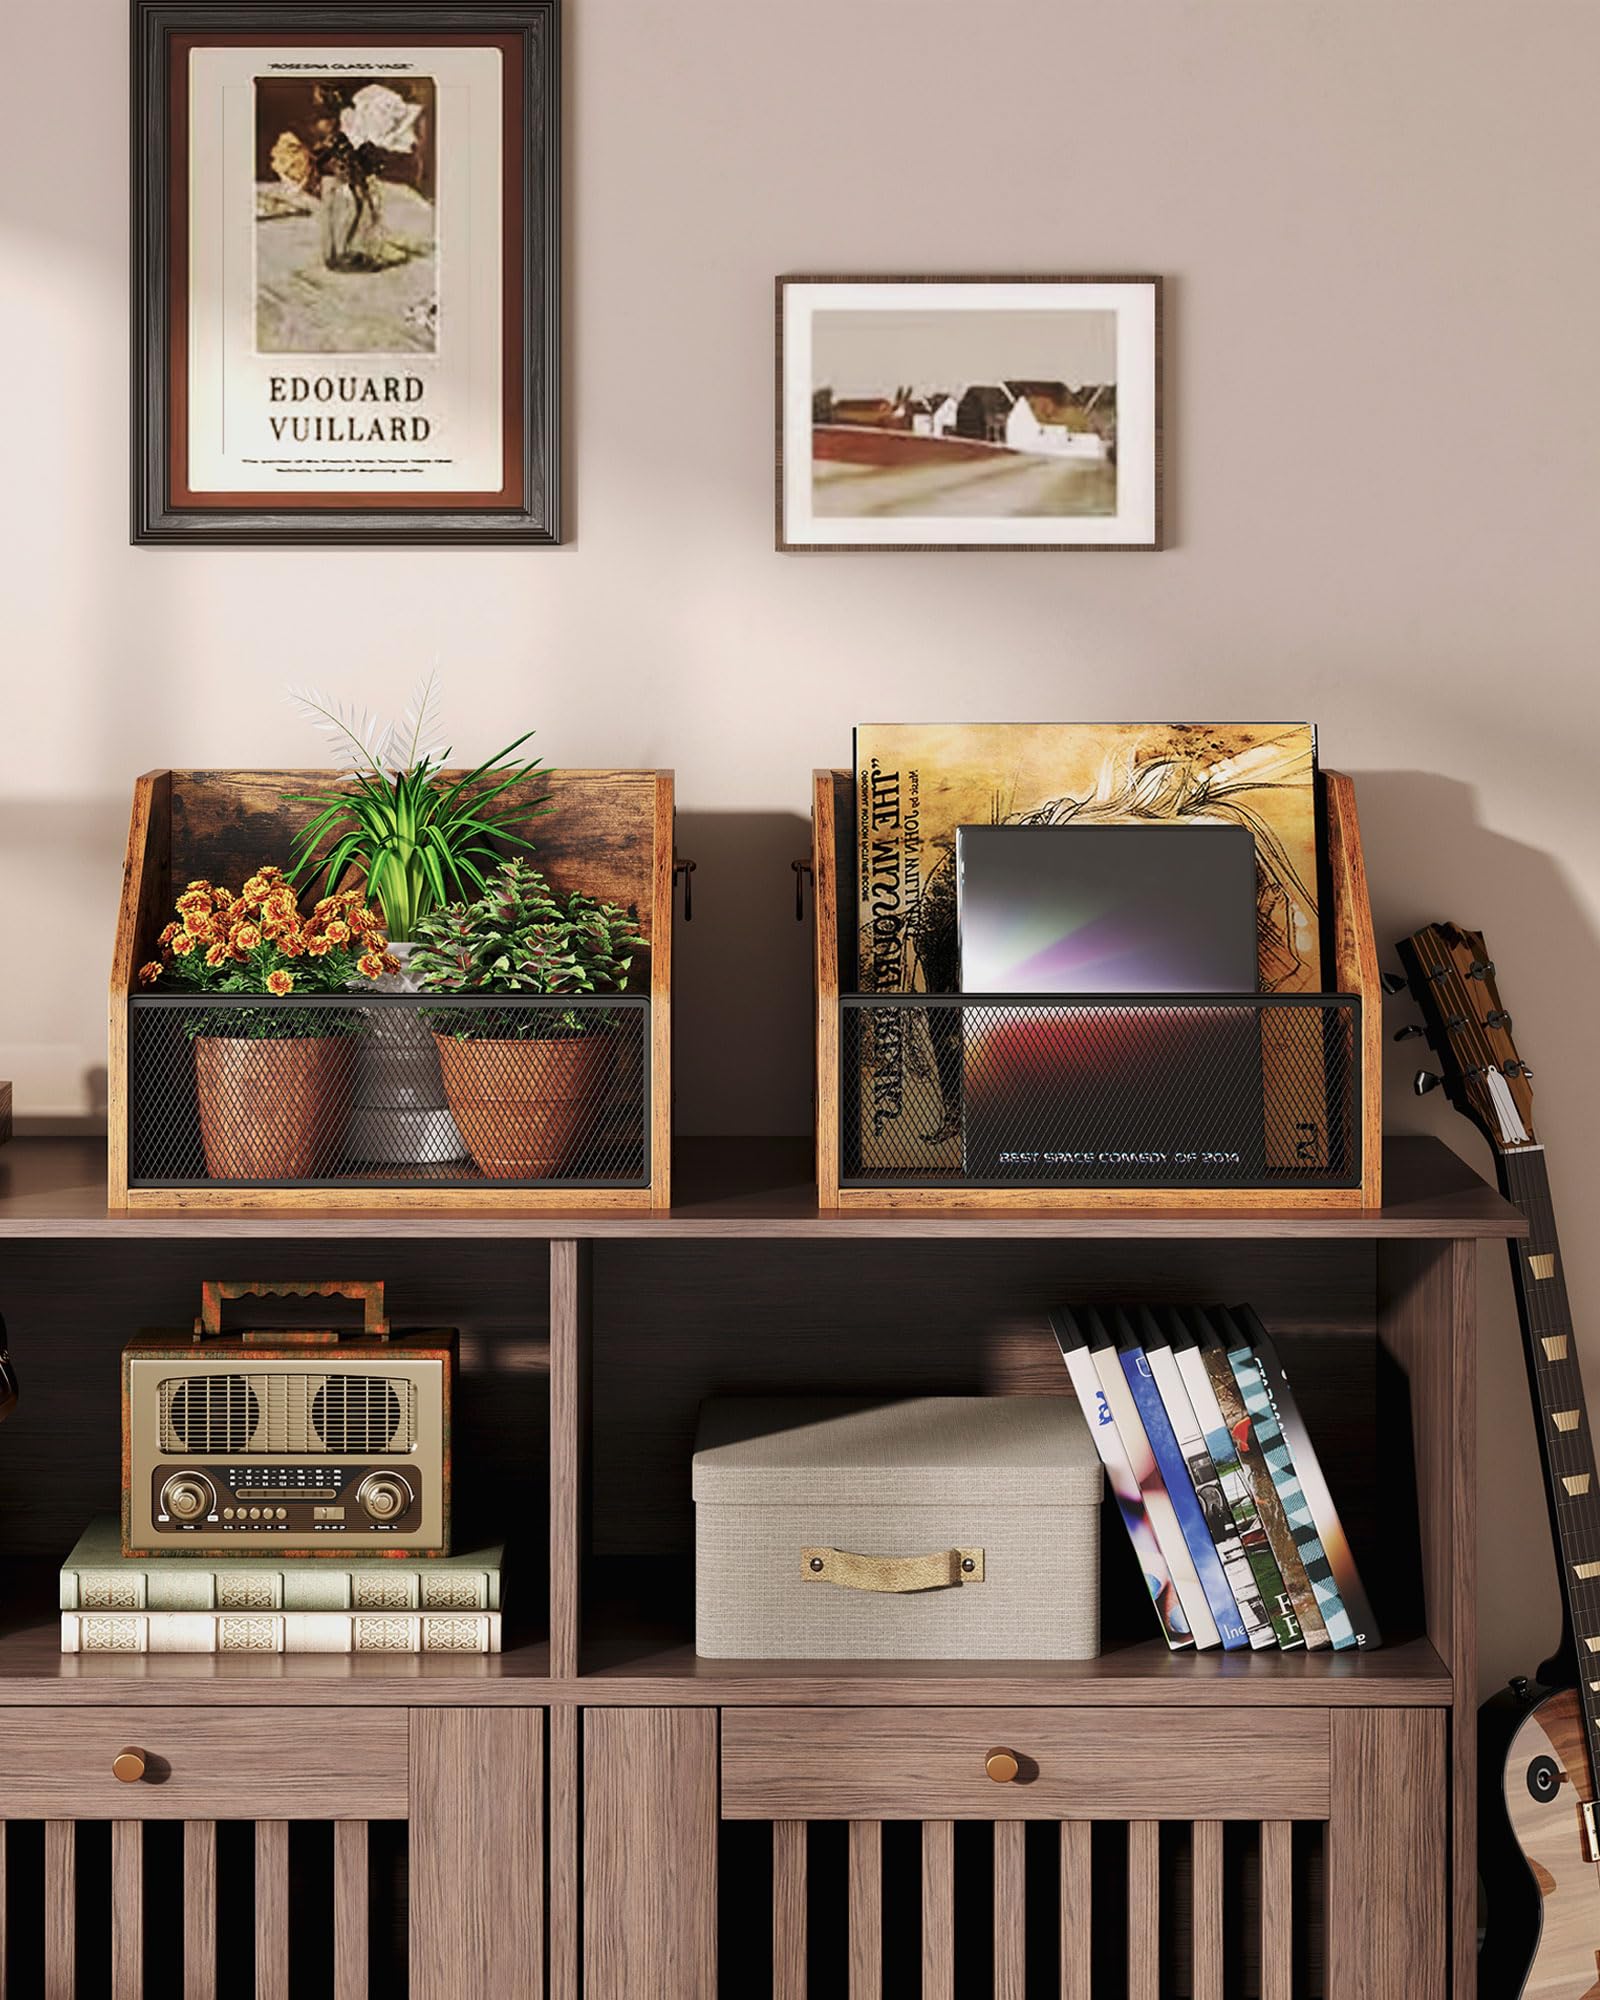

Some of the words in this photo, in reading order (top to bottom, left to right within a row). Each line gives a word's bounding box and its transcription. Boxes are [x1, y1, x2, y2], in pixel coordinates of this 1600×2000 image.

[269, 377, 424, 402] EDOUARD
[269, 416, 431, 442] VUILLARD
[999, 1152, 1039, 1163] BEST
[1043, 1152, 1095, 1163] SPACE
[1099, 1152, 1168, 1163] COMEDY
[1174, 1152, 1197, 1163] OF
